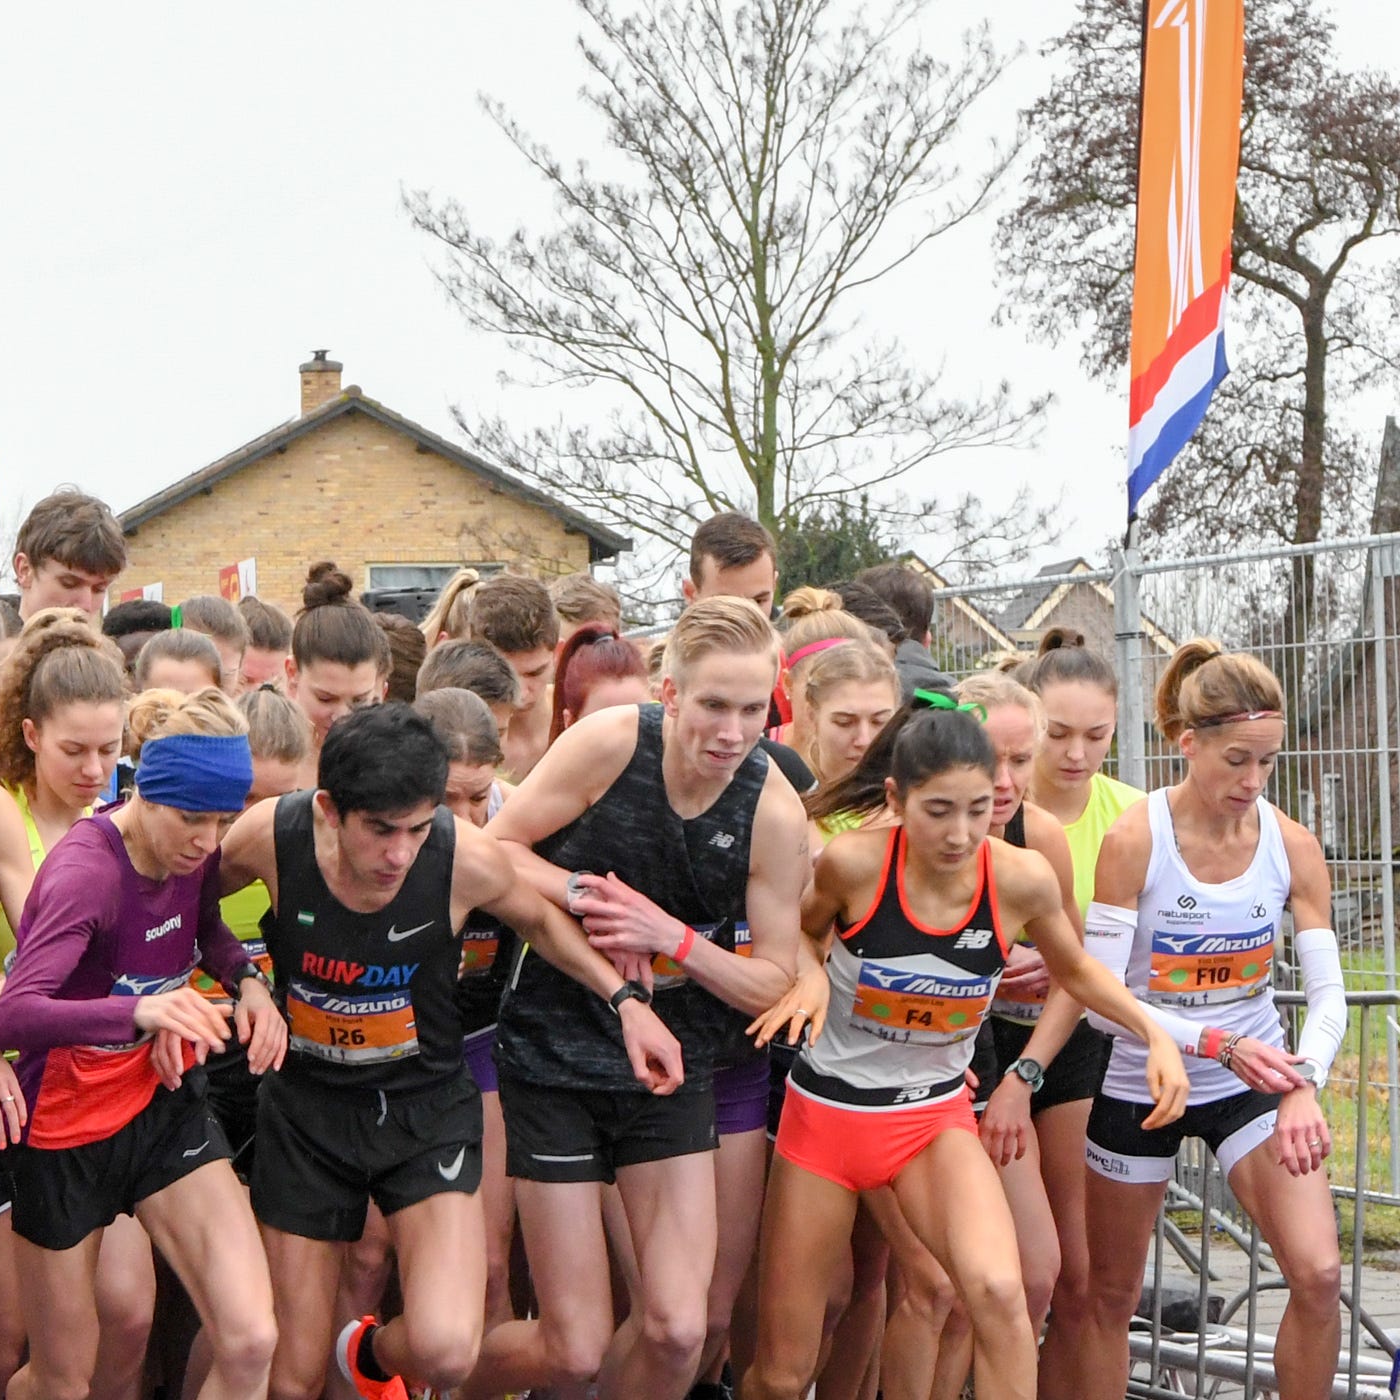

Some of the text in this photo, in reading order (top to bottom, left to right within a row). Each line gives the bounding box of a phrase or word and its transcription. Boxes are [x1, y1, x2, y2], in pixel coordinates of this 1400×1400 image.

[1157, 909, 1212, 920] natusport
[145, 913, 182, 942] saucony
[1195, 931, 1272, 953] MIZUNO
[1196, 966, 1231, 986] F10
[903, 978, 987, 998] MIZUNO
[322, 997, 406, 1015] MIZUNO
[904, 1008, 933, 1028] F4
